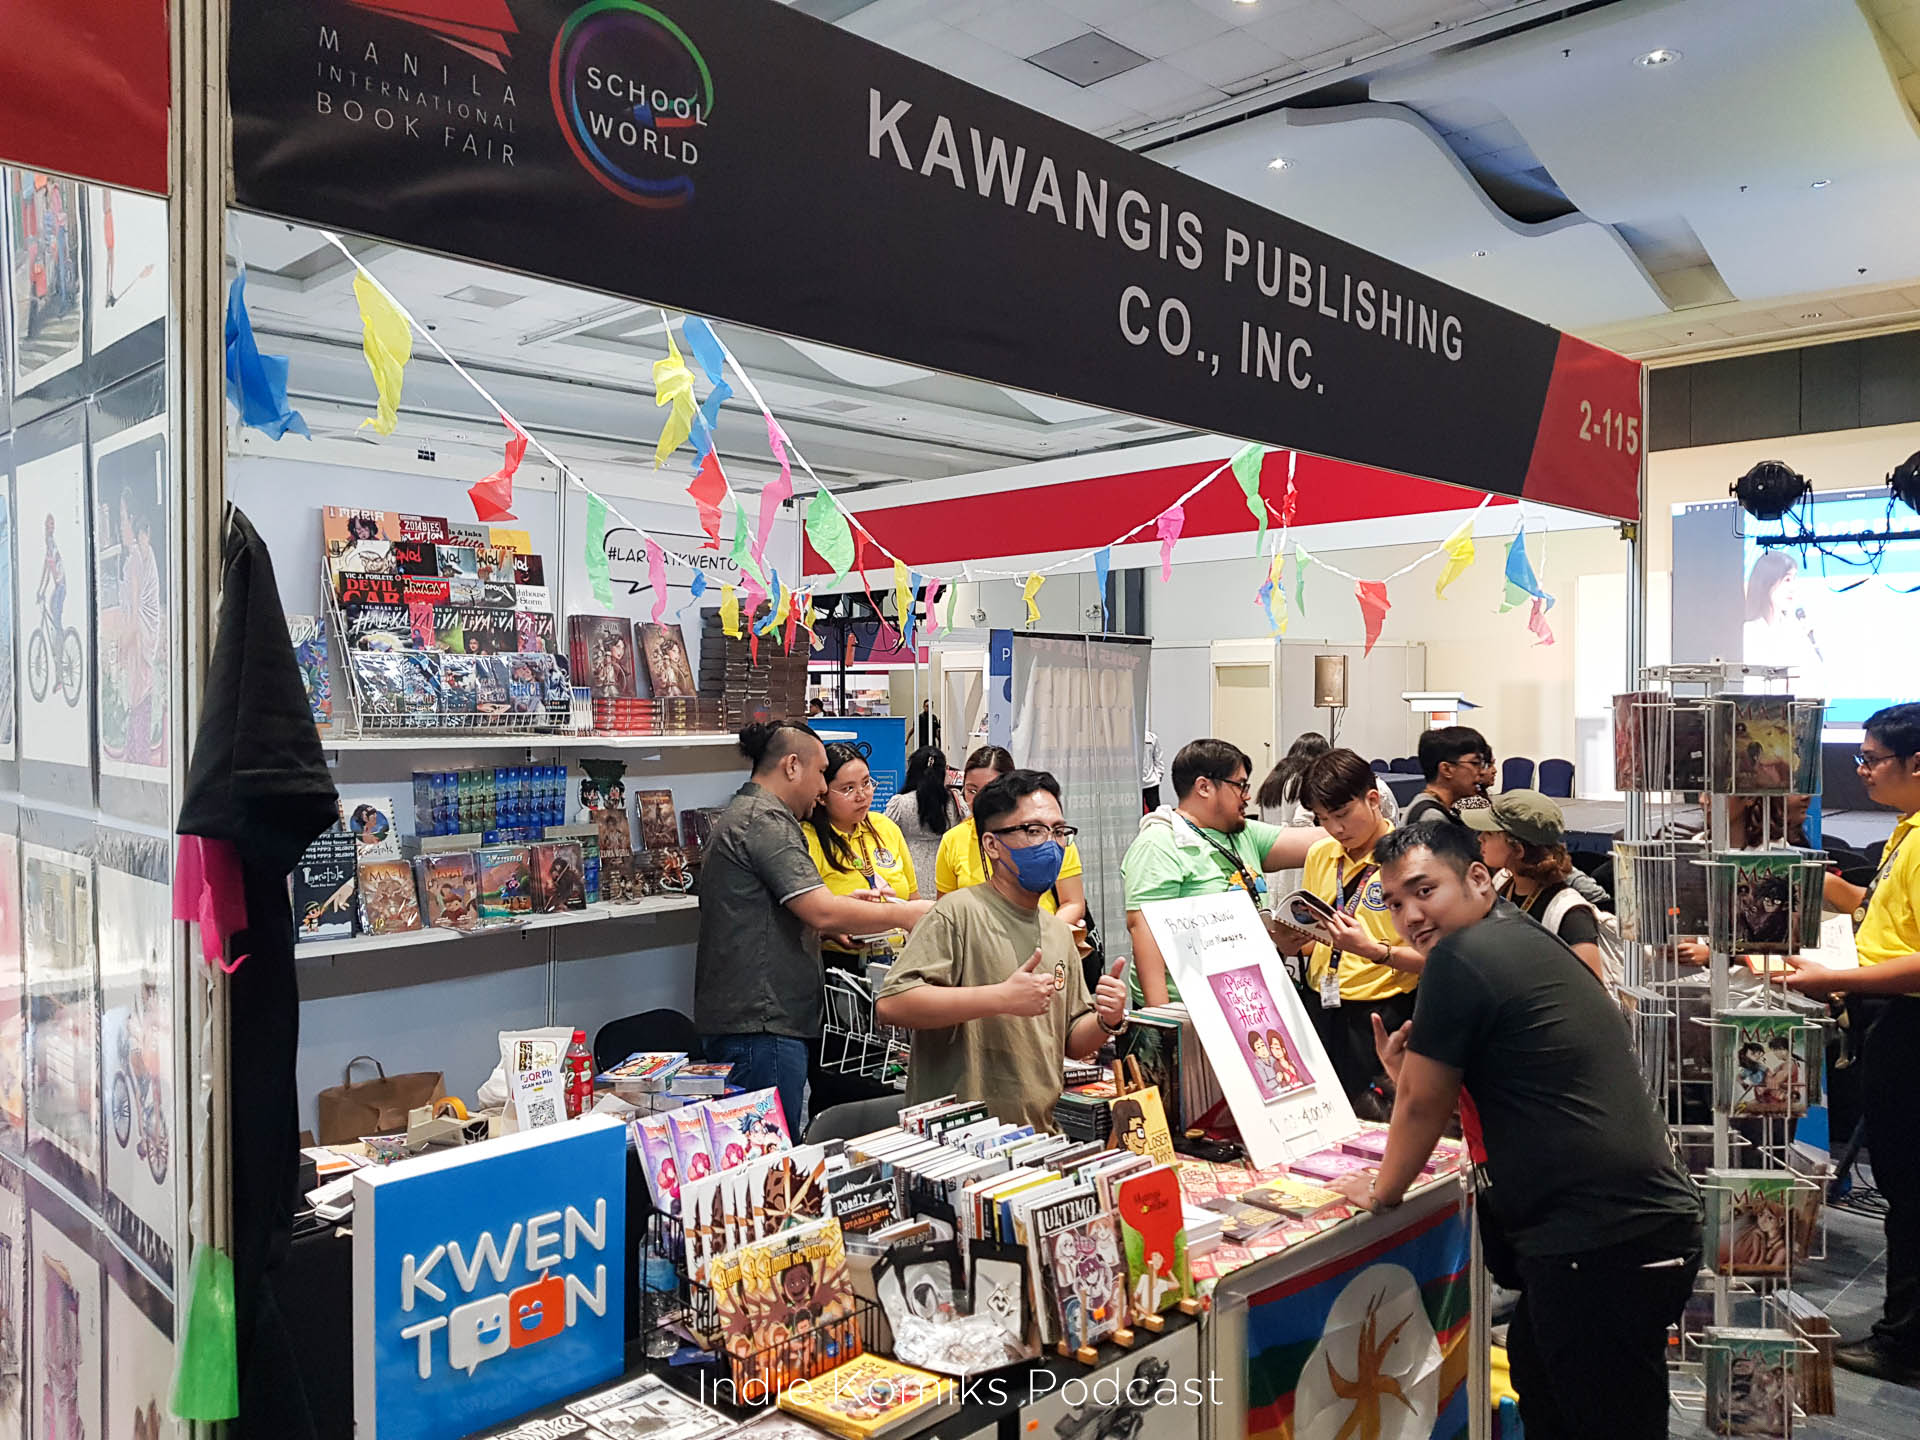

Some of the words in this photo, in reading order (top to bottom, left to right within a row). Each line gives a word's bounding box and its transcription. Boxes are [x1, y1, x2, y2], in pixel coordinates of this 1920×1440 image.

[317, 63, 516, 134] INTERNATIONAL
[318, 26, 517, 107] MANILA
[587, 66, 709, 127] SCHOOL
[316, 91, 420, 139] BOOK
[445, 126, 515, 167] FAIR
[590, 111, 699, 166] WORLD
[868, 87, 1204, 271] KAWANGIS
[1225, 227, 1464, 363] PUBLISHING
[1119, 284, 1220, 378] CO.,
[1240, 320, 1326, 396] INC.
[1579, 399, 1639, 456] 2-115
[404, 520, 441, 533] ZOMBIES
[346, 579, 397, 592] DEVIL
[1044, 1196, 1098, 1233] ULTIMO
[401, 1197, 607, 1313] KWEN
